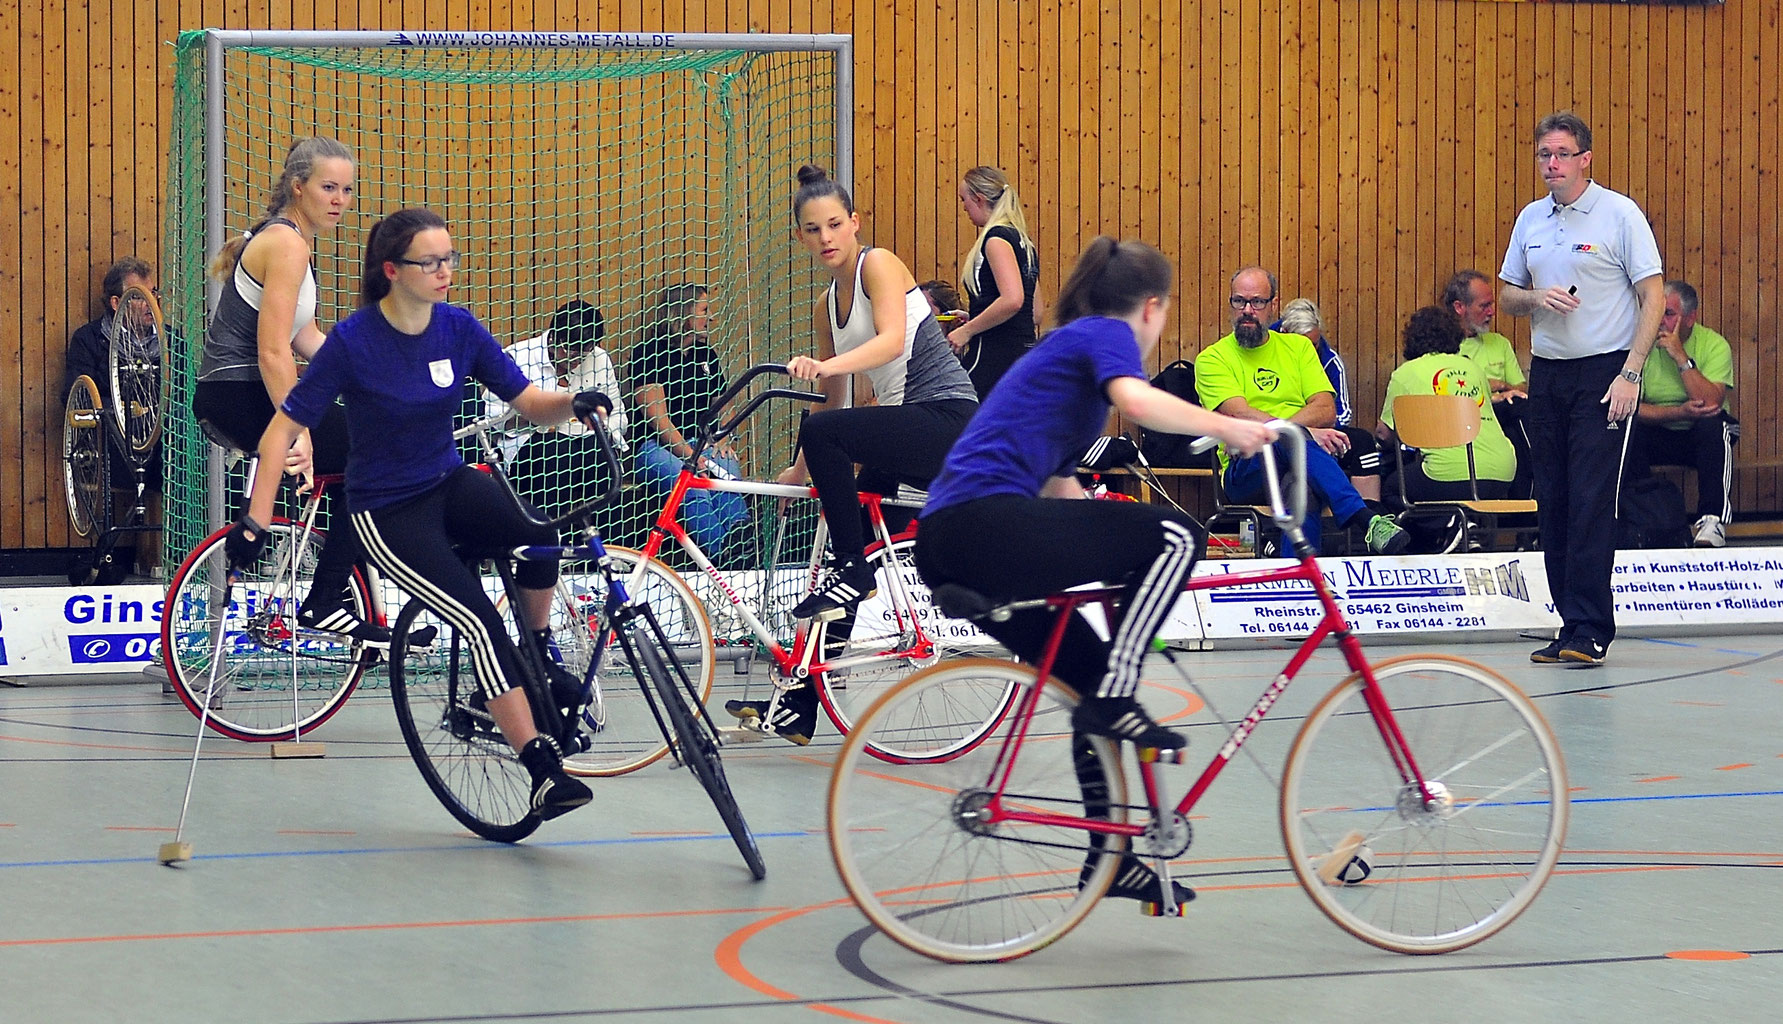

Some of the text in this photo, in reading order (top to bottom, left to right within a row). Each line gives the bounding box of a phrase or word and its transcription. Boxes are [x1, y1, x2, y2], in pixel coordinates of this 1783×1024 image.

[416, 32, 676, 48] WWW.JOHANNES-METALL.DE
[1342, 560, 1463, 587] MEIERLE
[1632, 563, 1646, 574] in
[1254, 601, 1464, 618] Rheinstr. 65462 Ginsheim
[1632, 600, 1712, 612] Innentüren
[1240, 623, 1265, 633] Tel.
[1268, 622, 1310, 633] 06144
[1377, 619, 1400, 630] Fax
[1404, 618, 1444, 629] 06144
[1455, 616, 1487, 628] 2281
